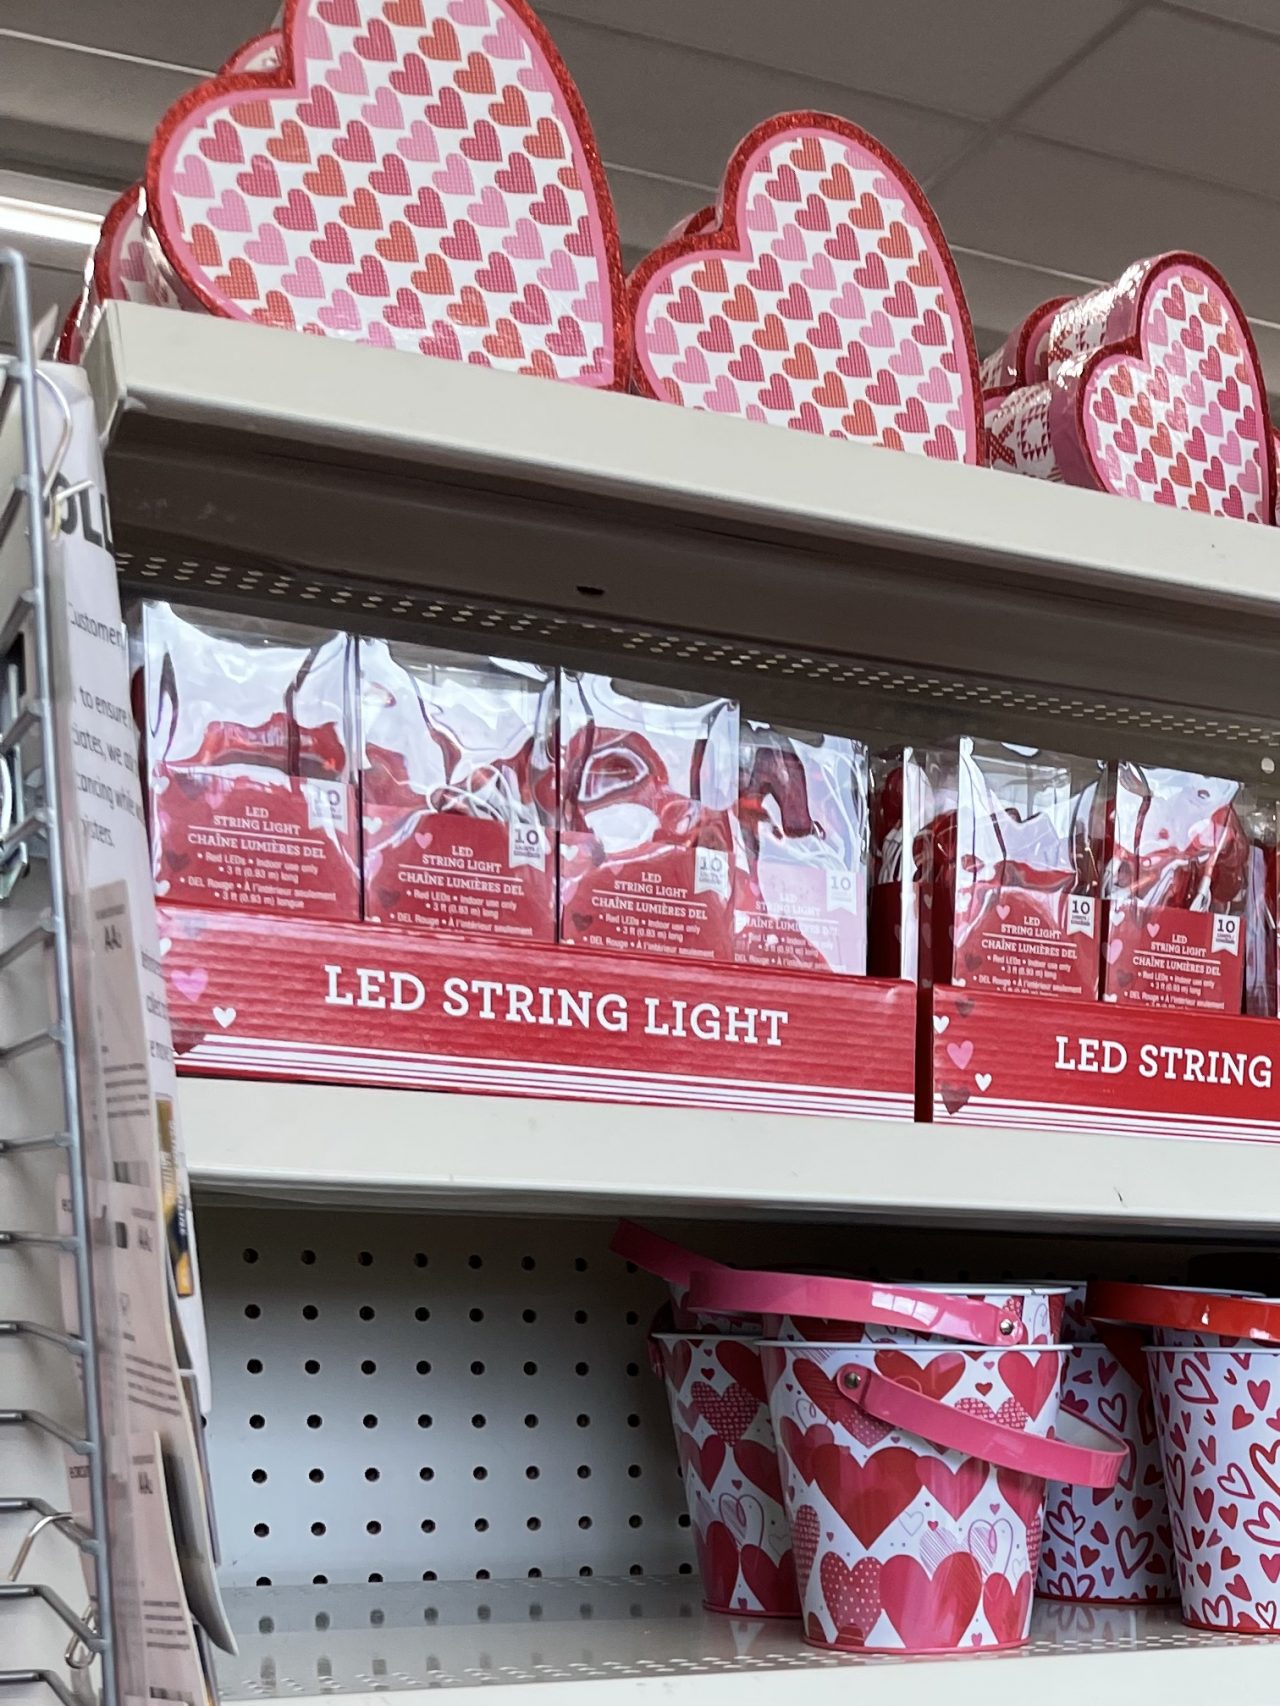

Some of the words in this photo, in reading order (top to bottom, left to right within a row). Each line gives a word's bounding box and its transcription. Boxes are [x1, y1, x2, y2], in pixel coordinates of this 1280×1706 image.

[245, 806, 269, 819] LED
[213, 815, 260, 831] STRING
[262, 823, 301, 836] LIGHT
[514, 828, 539, 845] 10
[303, 847, 326, 860] DEL
[452, 845, 473, 857] LED
[422, 854, 465, 868] STRING
[467, 860, 502, 873] LIGHT
[641, 872, 662, 883] LED
[503, 884, 525, 896] DEL
[614, 880, 654, 894] STRING
[655, 887, 688, 899] LIGHT
[688, 909, 708, 920] DEL
[1072, 900, 1090, 915] 10
[1023, 915, 1041, 926] LED
[1217, 919, 1236, 934] 10
[1001, 923, 1033, 936] STRING
[1035, 929, 1061, 940] LIGHT
[1172, 934, 1187, 944] LED
[1151, 941, 1180, 954] STRING
[1182, 947, 1206, 957] LIGHT
[325, 964, 426, 1012] LED
[442, 978, 628, 1032] STRING
[644, 998, 789, 1047] LIGHT
[1055, 1036, 1128, 1074] LED
[1138, 1045, 1273, 1090] STRING
